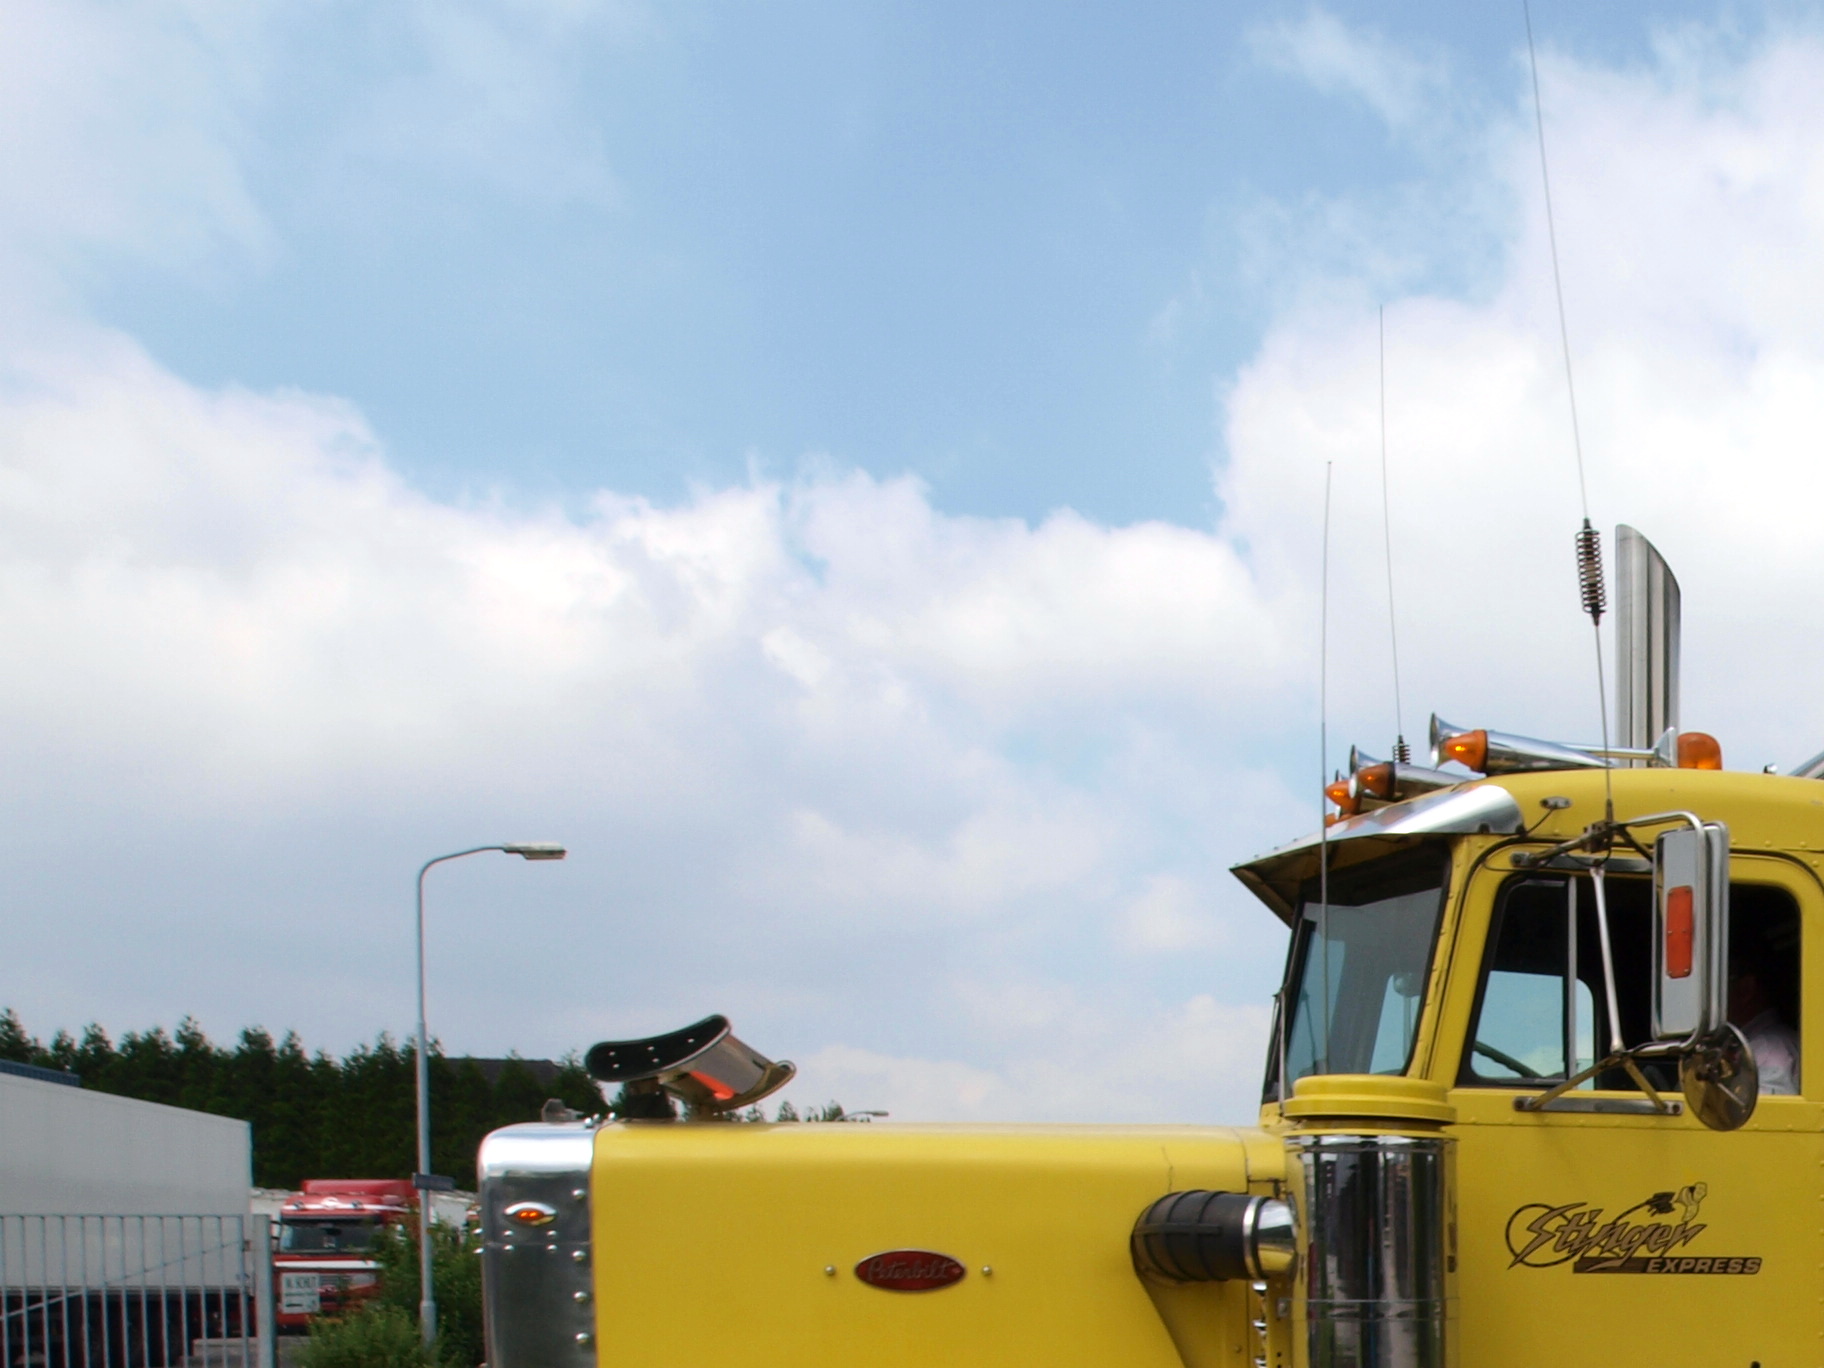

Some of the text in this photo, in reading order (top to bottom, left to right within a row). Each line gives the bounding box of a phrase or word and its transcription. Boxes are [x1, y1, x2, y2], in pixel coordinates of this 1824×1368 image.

[1507, 1202, 1708, 1270] Stinger
[867, 1257, 955, 1281] Peterbilt
[1647, 1258, 1761, 1273] EXPRESS
